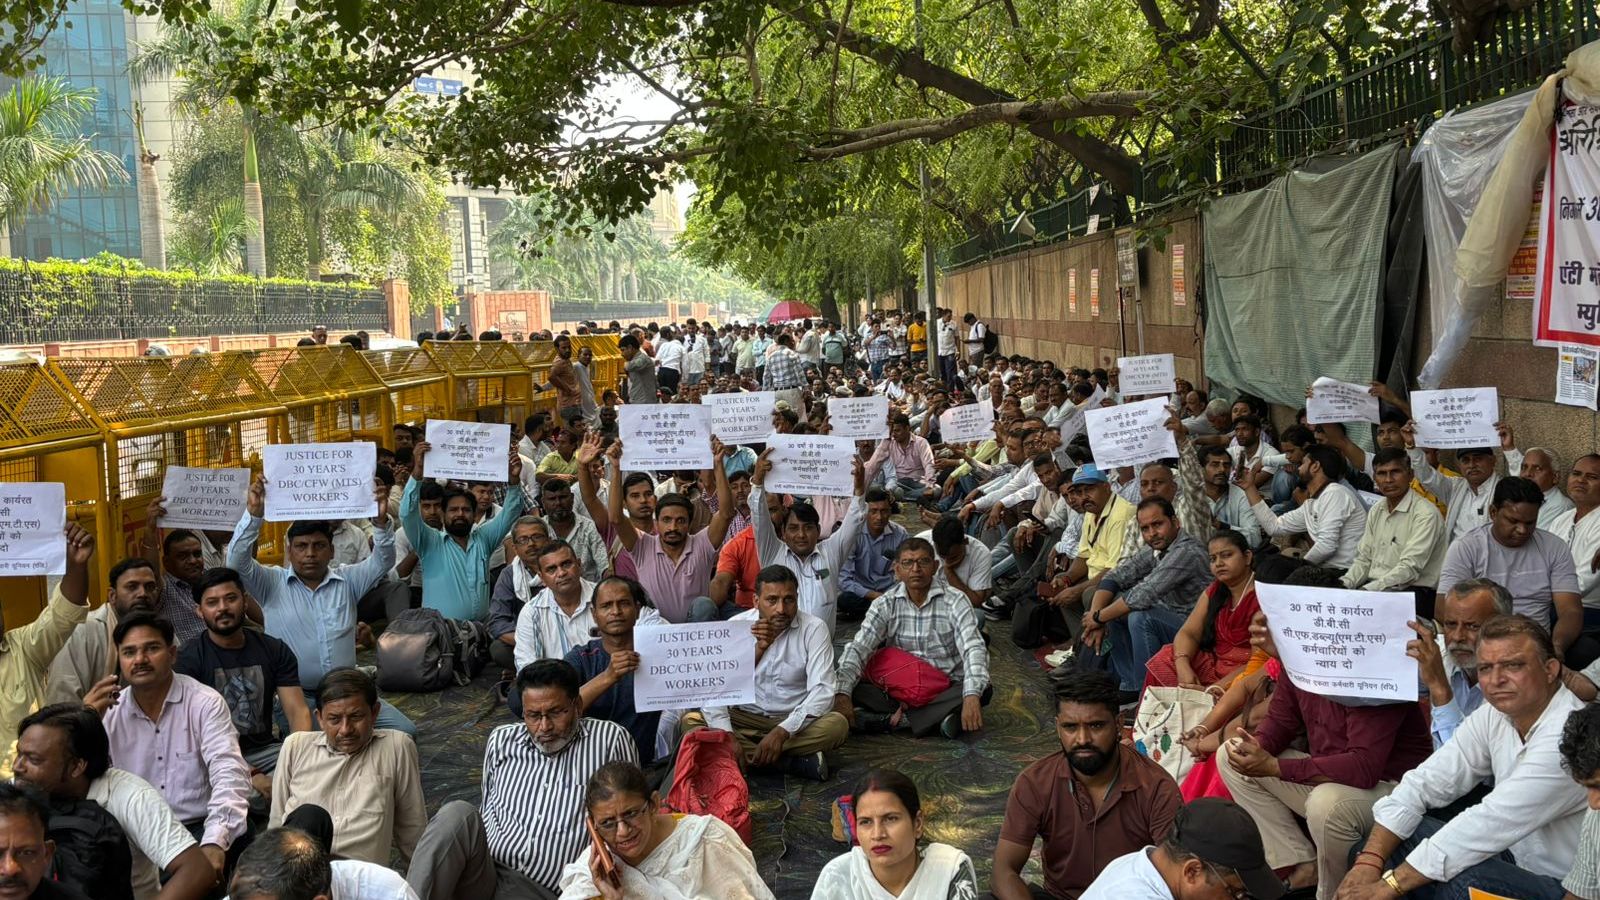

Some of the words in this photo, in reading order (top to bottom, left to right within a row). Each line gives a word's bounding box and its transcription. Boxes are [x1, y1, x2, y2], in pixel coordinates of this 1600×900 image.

[1586, 196, 1600, 221] 3
[1559, 261, 1585, 285] एंटी
[1577, 301, 1600, 330] म्यु
[285, 451, 329, 460] JUSTICE
[332, 450, 353, 458] FOR
[294, 466, 304, 474] 30
[308, 465, 346, 473] YEAR'S
[278, 480, 329, 488] DBC/CFW
[332, 478, 361, 489] (MTS)
[3, 495, 32, 504] कार्यरत
[173, 497, 214, 506] DBC/CFW
[293, 492, 349, 502] WORKER'S
[0, 506, 10, 516] सी
[182, 508, 228, 516] WORKER'S
[10, 531, 21, 540] को
[1290, 604, 1300, 612] 30
[1327, 603, 1336, 615] से
[1341, 605, 1373, 617] कार्यरत
[1314, 617, 1350, 630] डी.बी.सी
[658, 631, 704, 644] JUSTICE
[708, 629, 730, 638] FOR
[667, 649, 679, 659] 30
[682, 645, 722, 657] YEAR'S
[1353, 646, 1365, 657] को
[650, 662, 704, 675] DBC/CFW
[707, 660, 739, 671] (MTS)
[1315, 659, 1336, 669] न्याय
[1343, 659, 1352, 669] दो
[665, 676, 725, 690] WORKER'S
